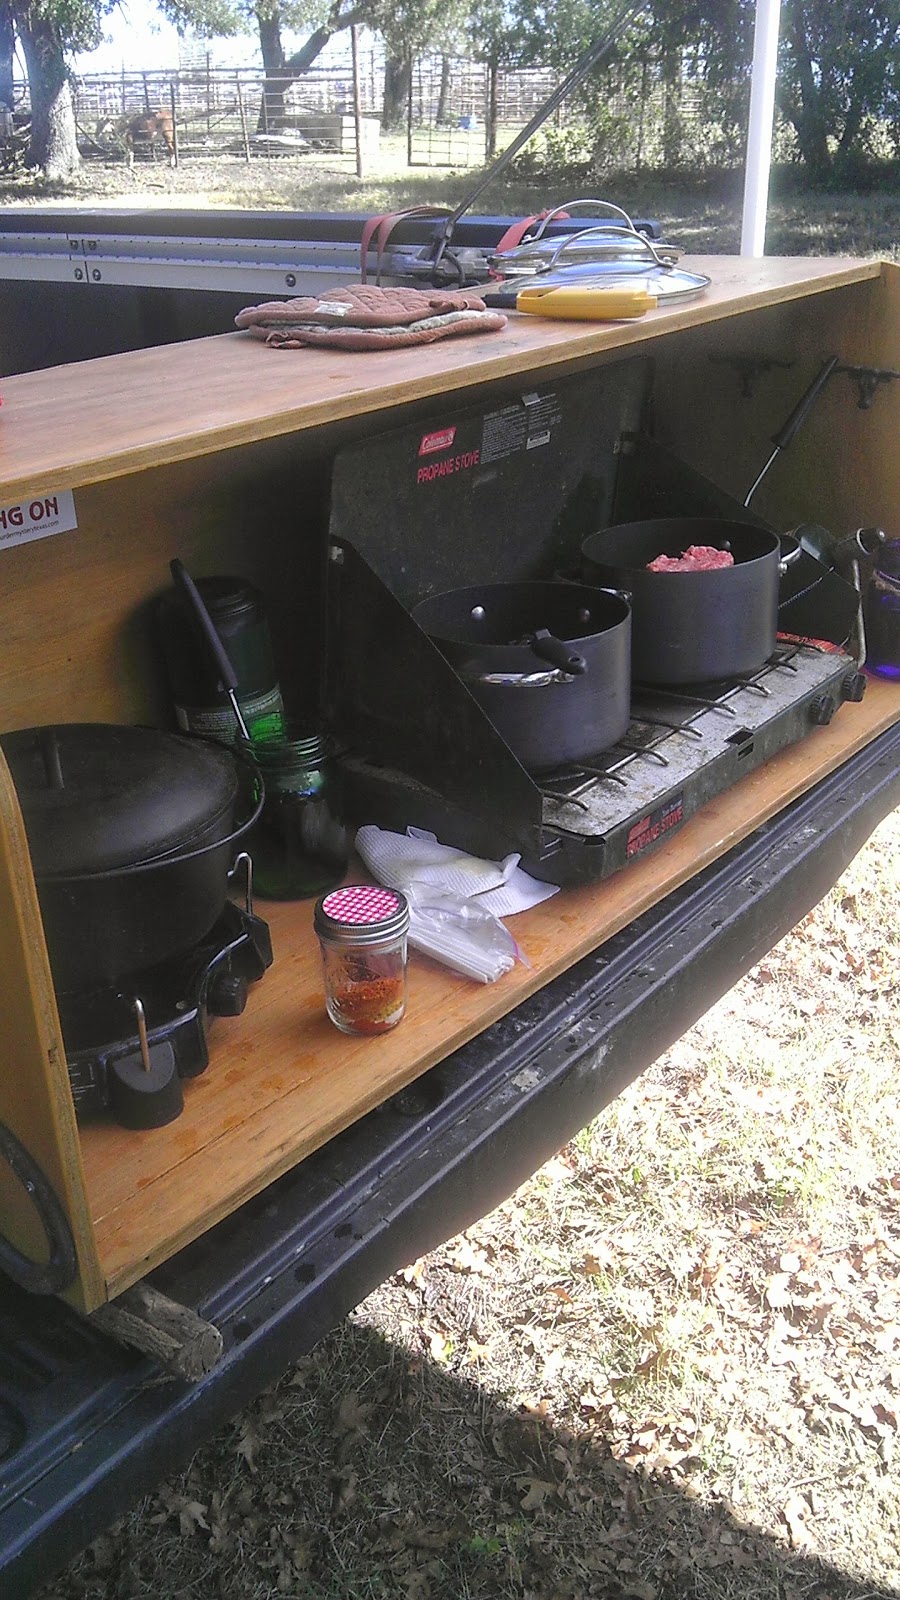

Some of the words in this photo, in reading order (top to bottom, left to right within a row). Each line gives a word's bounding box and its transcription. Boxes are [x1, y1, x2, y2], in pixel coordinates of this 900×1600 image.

[417, 458, 454, 484] PROPANE
[455, 449, 480, 471] STOVE
[29, 496, 59, 521] ON
